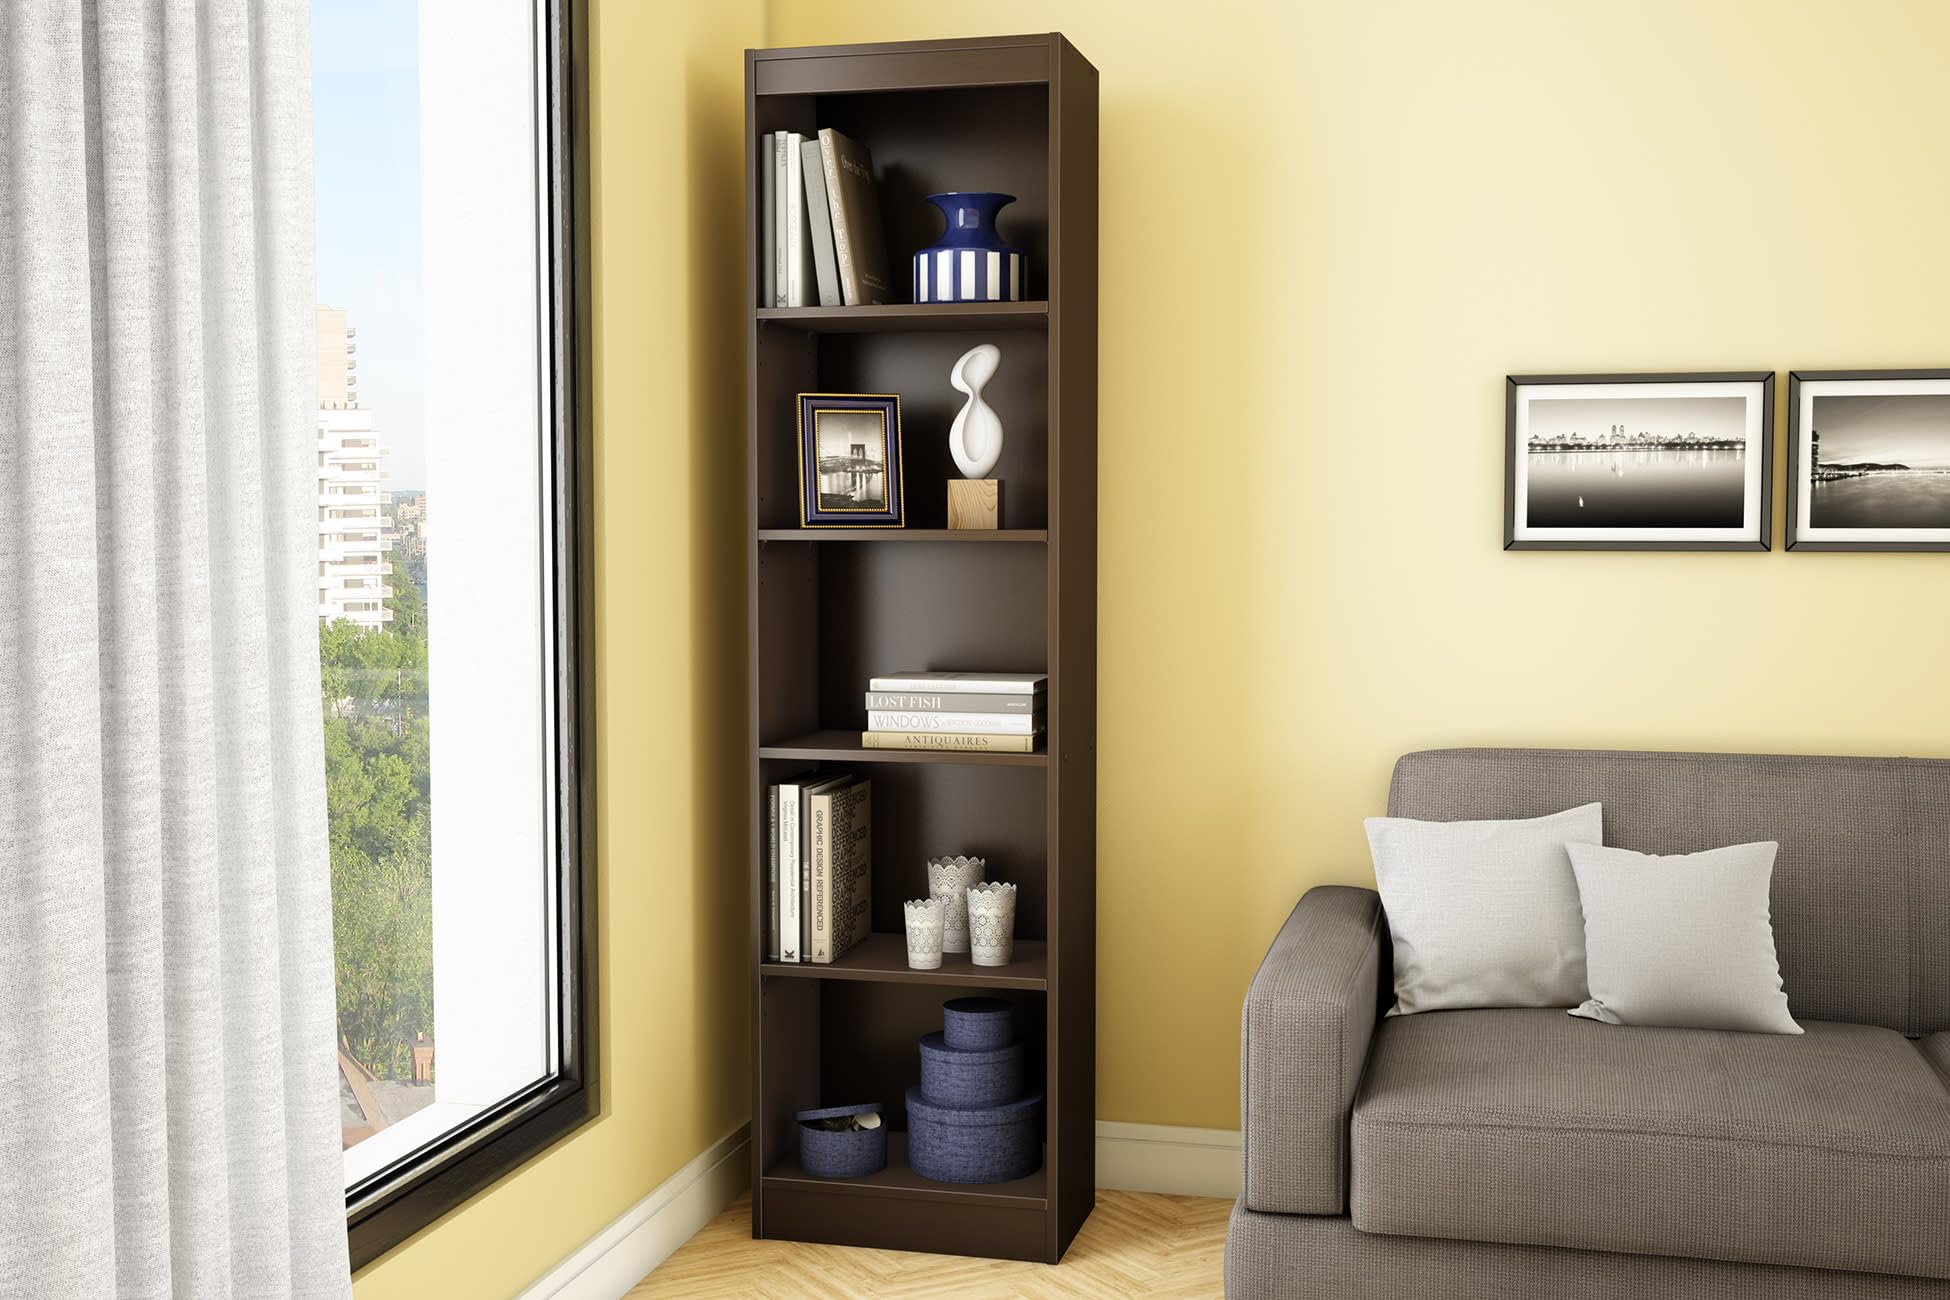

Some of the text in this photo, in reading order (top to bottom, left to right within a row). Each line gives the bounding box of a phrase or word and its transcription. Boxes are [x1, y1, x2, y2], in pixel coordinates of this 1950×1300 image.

[821, 134, 848, 265] Over the Top
[869, 695, 942, 709] LOST FISH
[873, 714, 940, 728] WINDOWS
[904, 735, 989, 747] ANTIQUAIRES
[816, 847, 824, 878] DESIGN
[816, 879, 824, 932] REFERENCED
